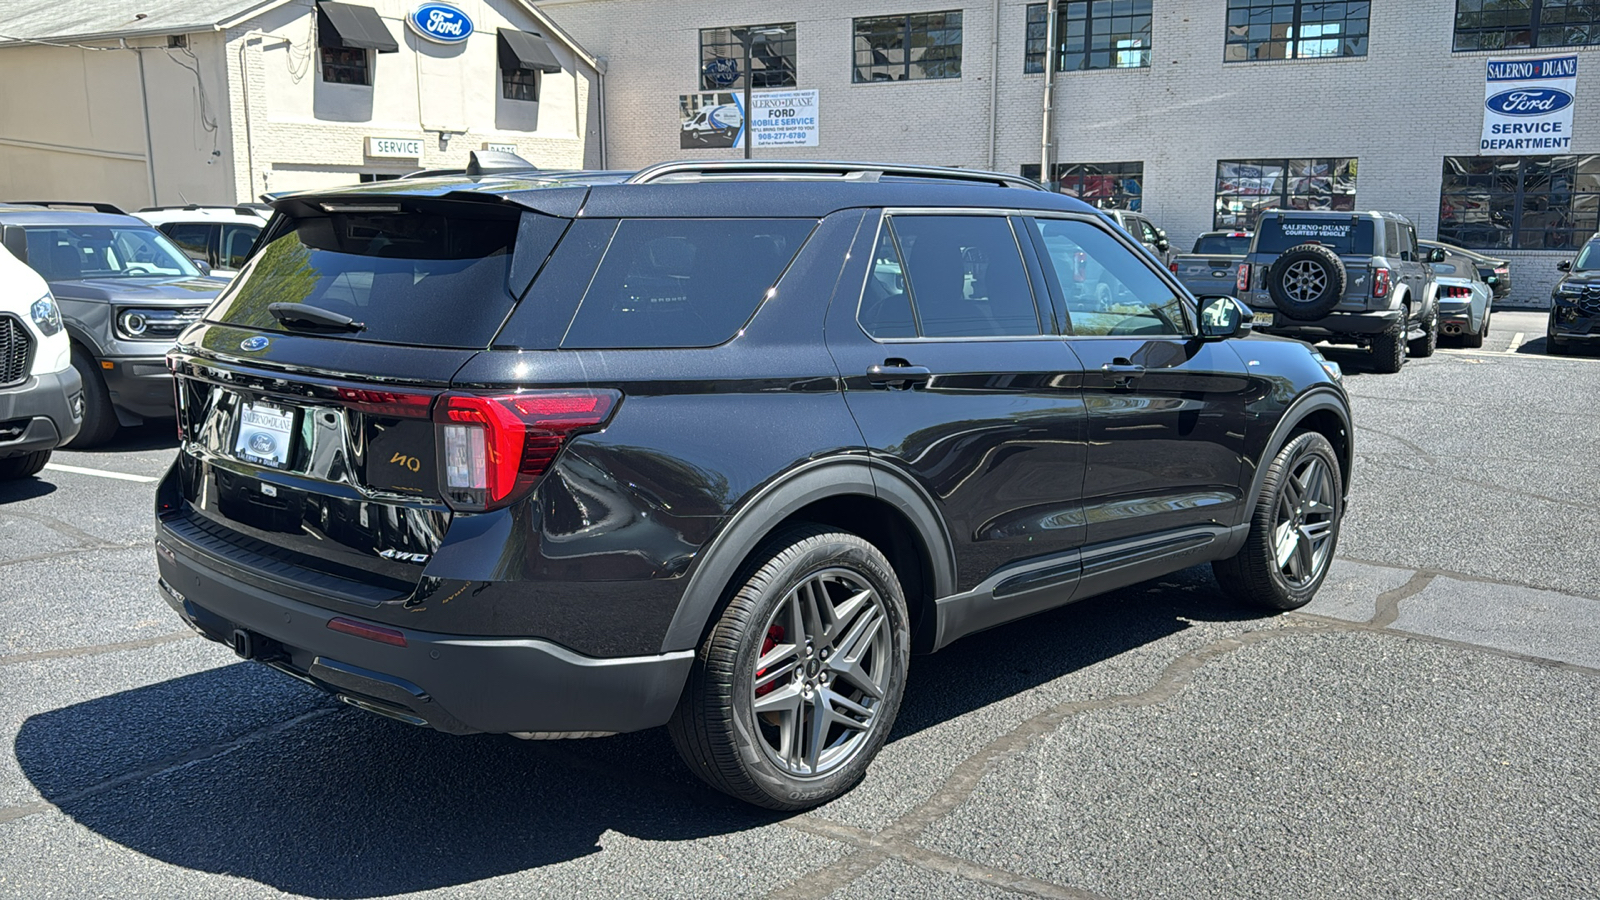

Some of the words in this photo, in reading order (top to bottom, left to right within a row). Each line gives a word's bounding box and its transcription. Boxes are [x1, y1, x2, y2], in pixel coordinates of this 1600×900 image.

[427, 9, 463, 36] Ford
[1488, 63, 1533, 79] SALERNO
[1542, 59, 1576, 76] DUANE
[751, 99, 781, 109] ALERNO
[785, 97, 813, 107] DUANE
[1502, 91, 1556, 111] Ford
[768, 108, 795, 118] FORD
[781, 117, 814, 126] SERVICE
[1491, 122, 1562, 134] SERVICE
[758, 132, 806, 140] 908-277-6780
[378, 140, 419, 153] SERVICE
[1481, 137, 1571, 149] DEPARTMENT
[243, 411, 269, 426] SALERNO
[253, 435, 271, 451] Ford
